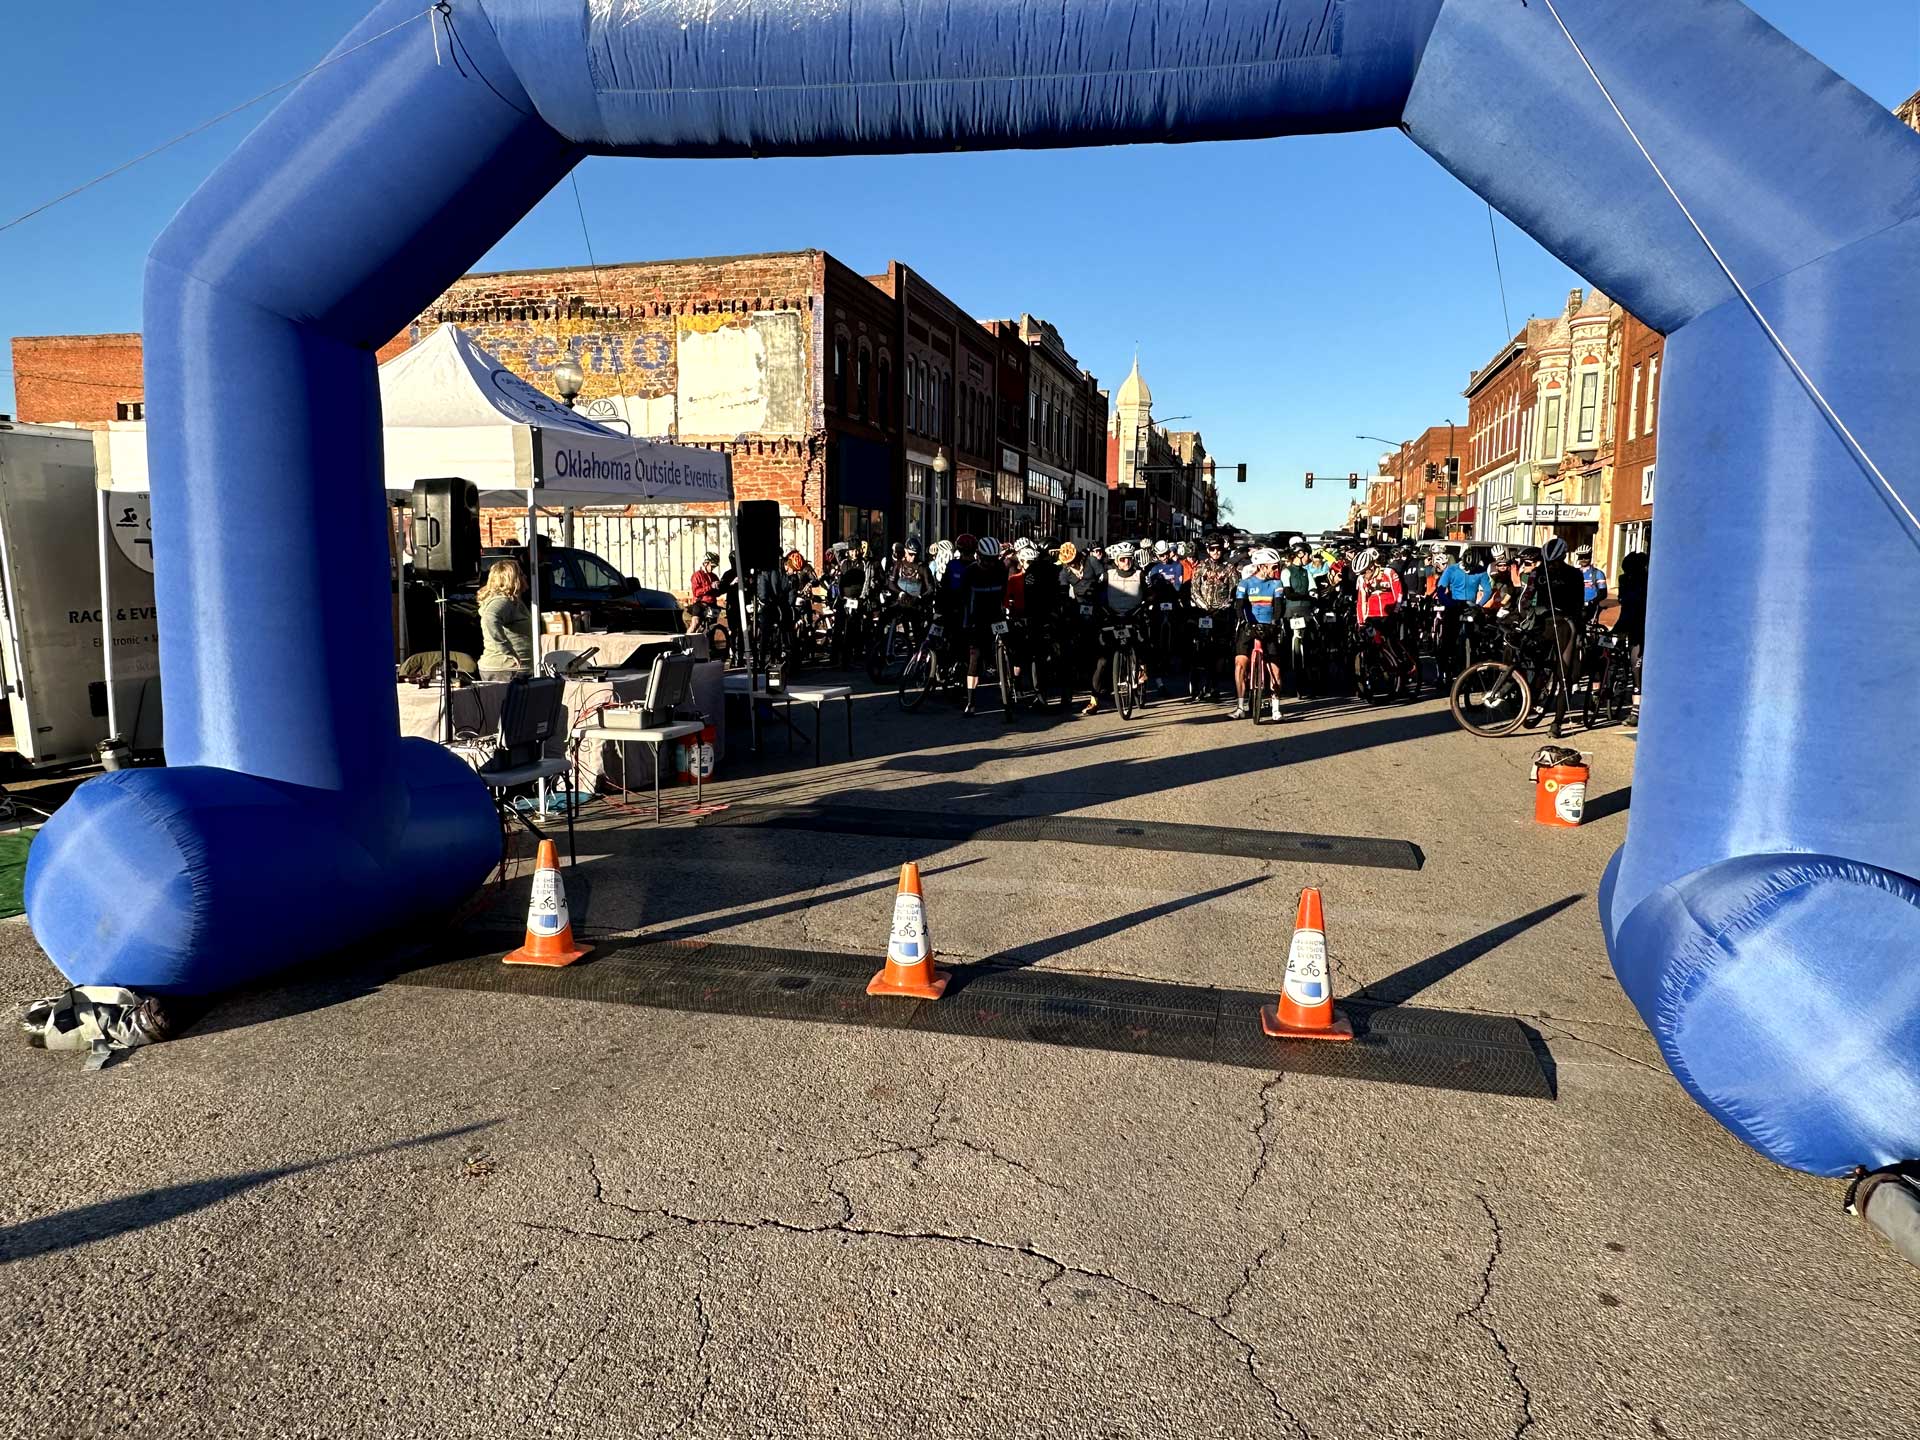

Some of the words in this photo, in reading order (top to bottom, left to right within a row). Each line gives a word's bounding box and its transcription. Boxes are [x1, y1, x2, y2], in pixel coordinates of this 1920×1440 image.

[555, 449, 631, 481] Oklahoma
[634, 458, 682, 486] Outside
[683, 464, 717, 488] Events
[1526, 508, 1568, 516] LCORCE
[69, 610, 112, 623] RAC
[116, 608, 128, 621] &
